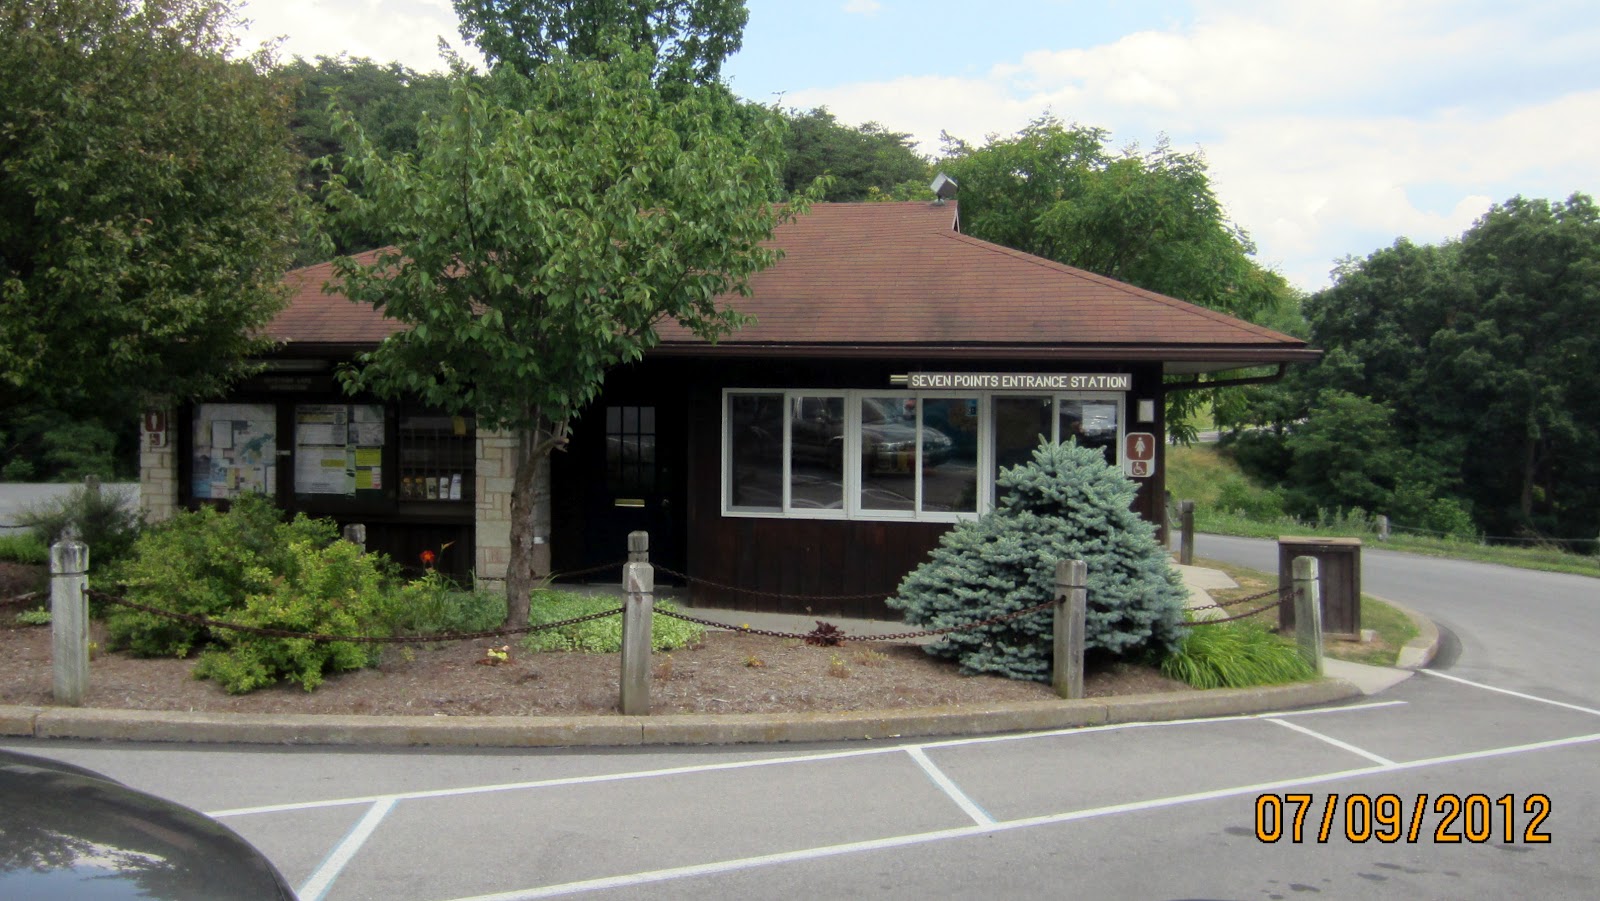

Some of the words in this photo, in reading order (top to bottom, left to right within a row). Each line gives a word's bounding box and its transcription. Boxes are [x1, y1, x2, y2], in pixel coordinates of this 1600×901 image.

[911, 374, 951, 388] SEVEN
[954, 374, 999, 388] POINTS
[1002, 375, 1067, 388] ENTRANCE
[1070, 375, 1127, 389] STATION
